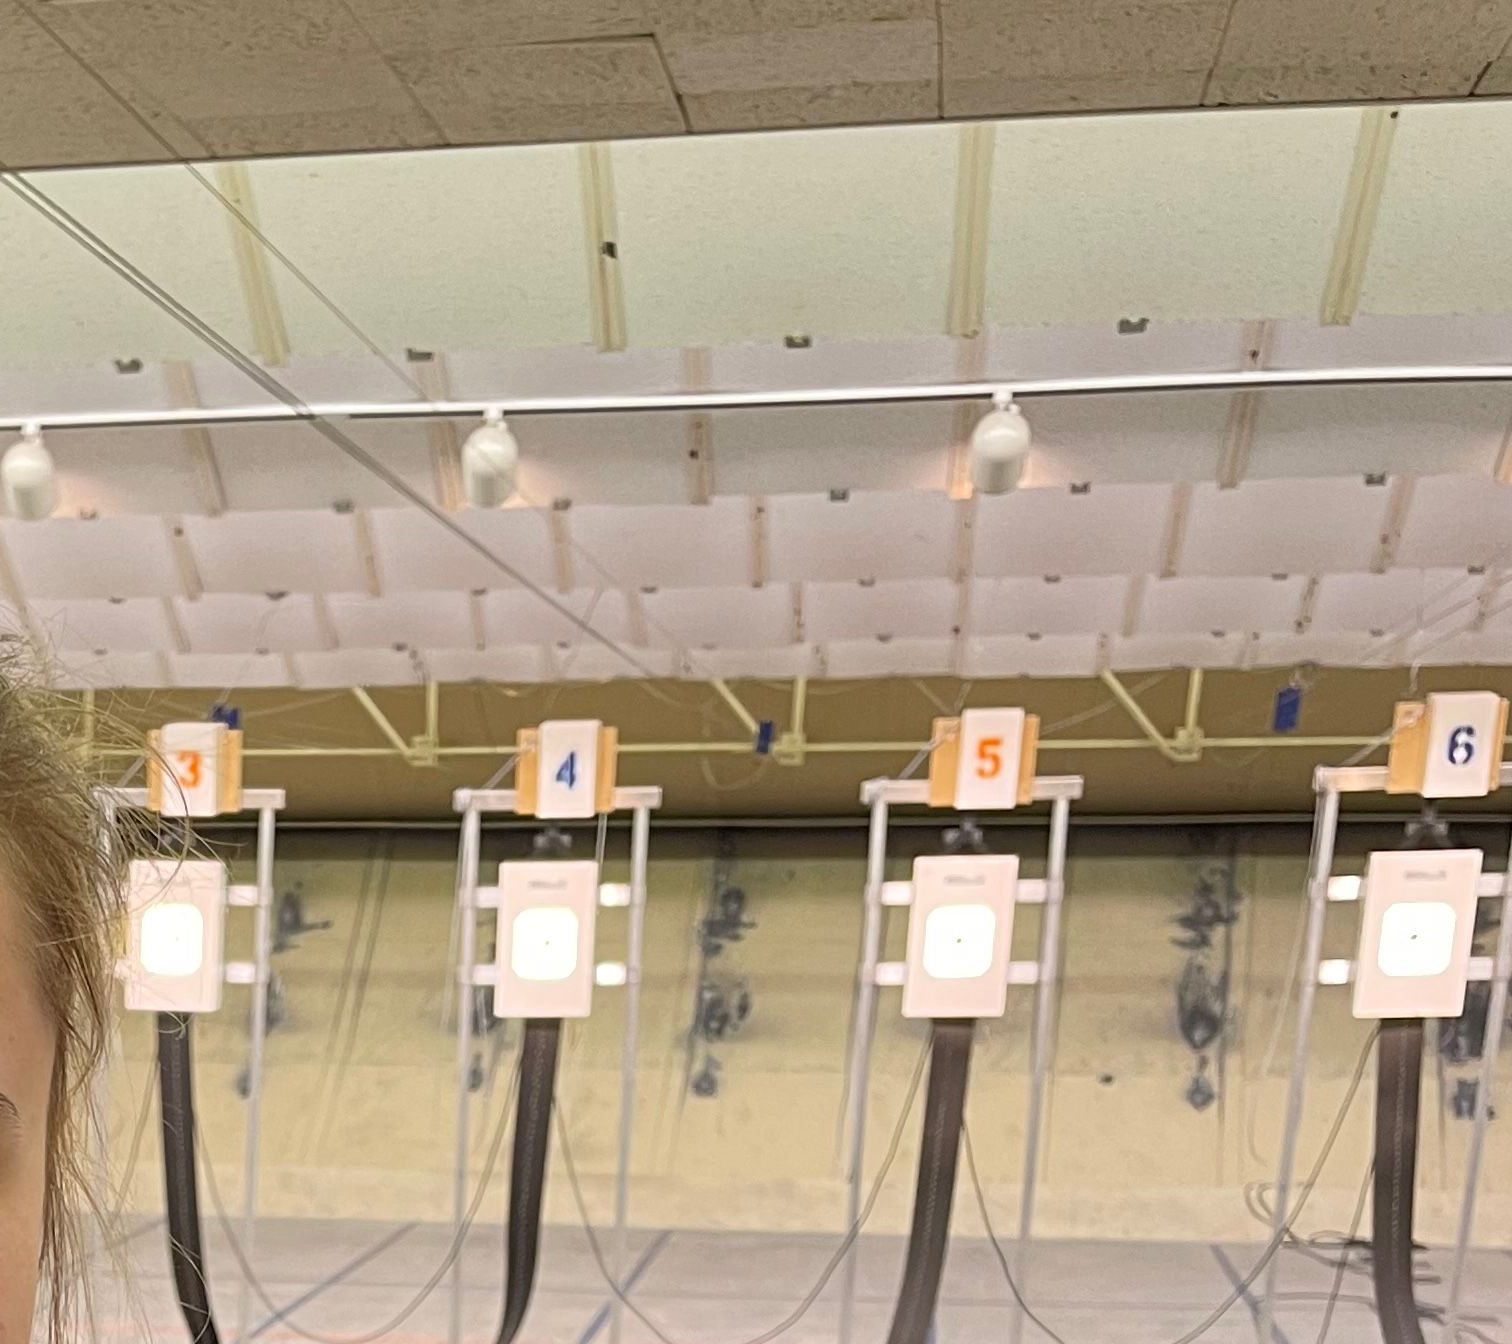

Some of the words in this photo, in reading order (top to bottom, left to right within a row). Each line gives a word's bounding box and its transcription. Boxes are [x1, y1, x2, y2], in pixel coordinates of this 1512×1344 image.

[976, 737, 1002, 778] 5
[1448, 726, 1475, 765] 6
[177, 750, 201, 788] 3
[555, 750, 576, 789] 4
